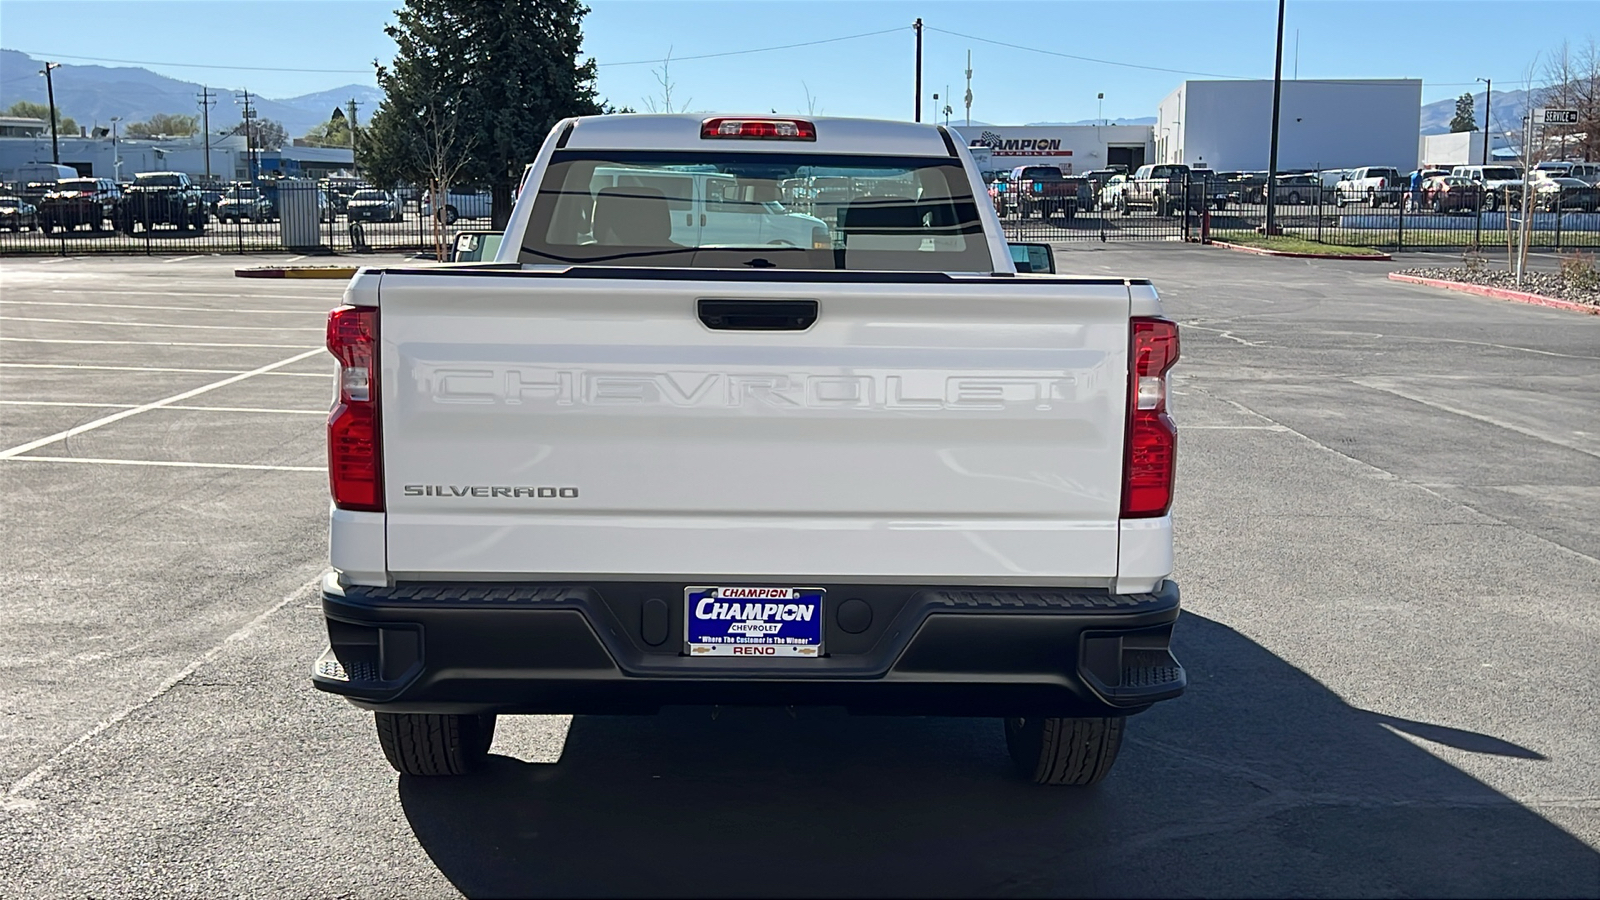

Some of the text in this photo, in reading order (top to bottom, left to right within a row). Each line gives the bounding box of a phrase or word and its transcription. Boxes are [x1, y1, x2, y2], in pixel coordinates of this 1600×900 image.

[1546, 111, 1569, 122] SERVICE
[433, 369, 1077, 411] CHEVROLET
[404, 485, 580, 498] SILVERADO
[723, 588, 788, 598] CHAMPION
[695, 598, 814, 621] CHAMPION
[733, 647, 776, 655] RENO
